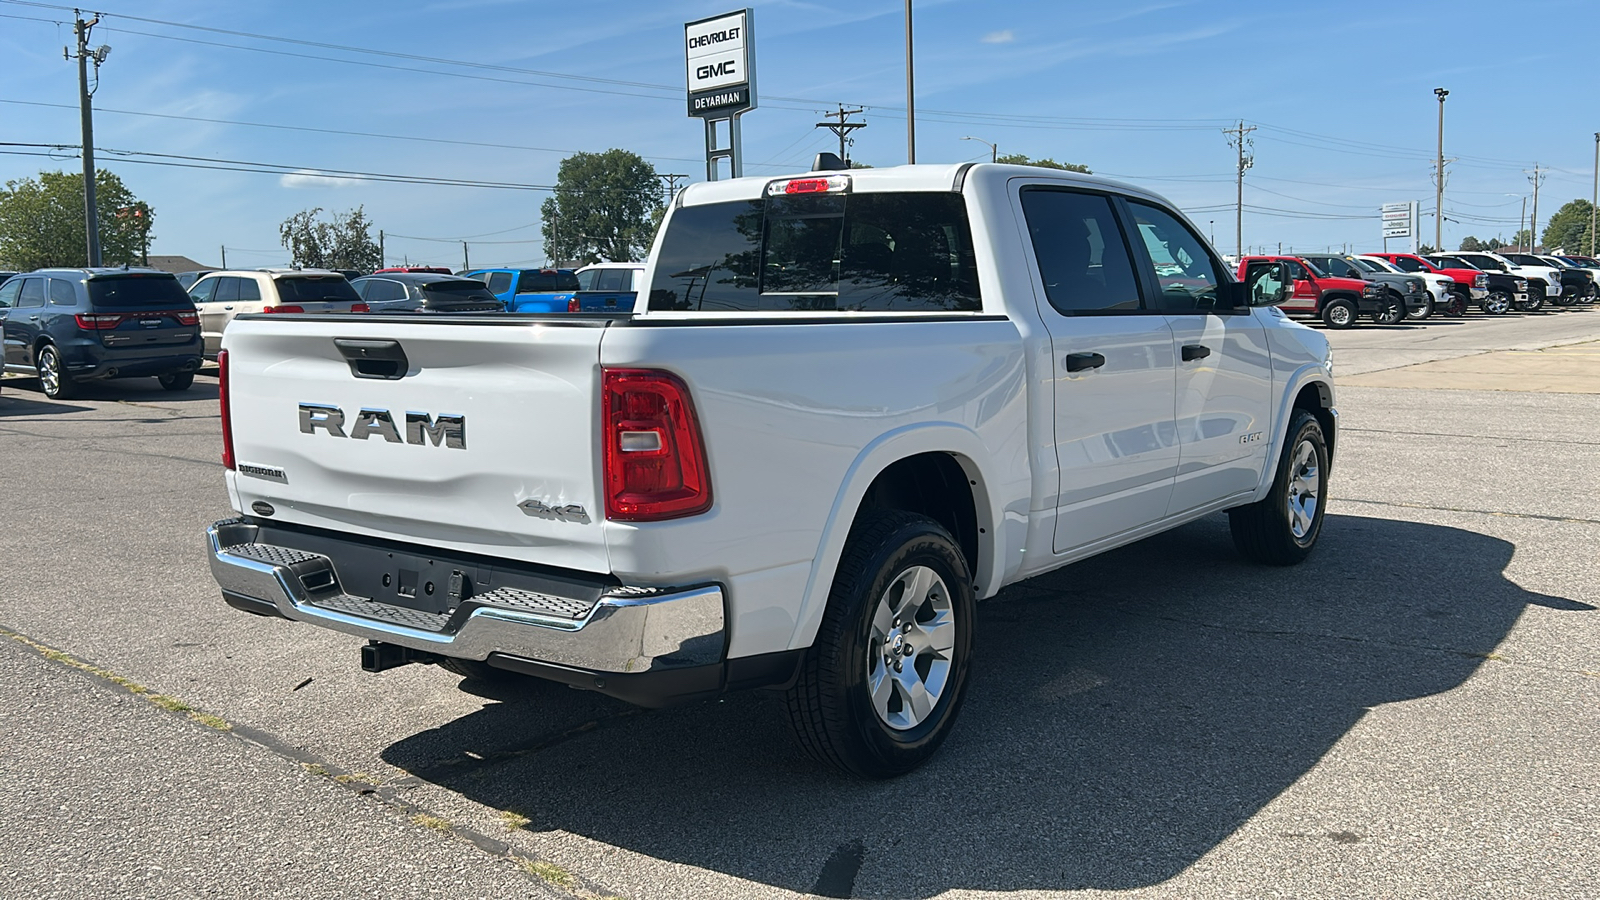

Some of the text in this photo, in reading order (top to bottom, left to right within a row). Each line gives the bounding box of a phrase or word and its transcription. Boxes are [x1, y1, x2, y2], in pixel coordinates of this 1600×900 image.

[689, 27, 740, 49] CHEVROLET
[697, 60, 735, 80] GMC
[695, 92, 739, 109] DEYARMAN
[299, 401, 467, 450] RAM
